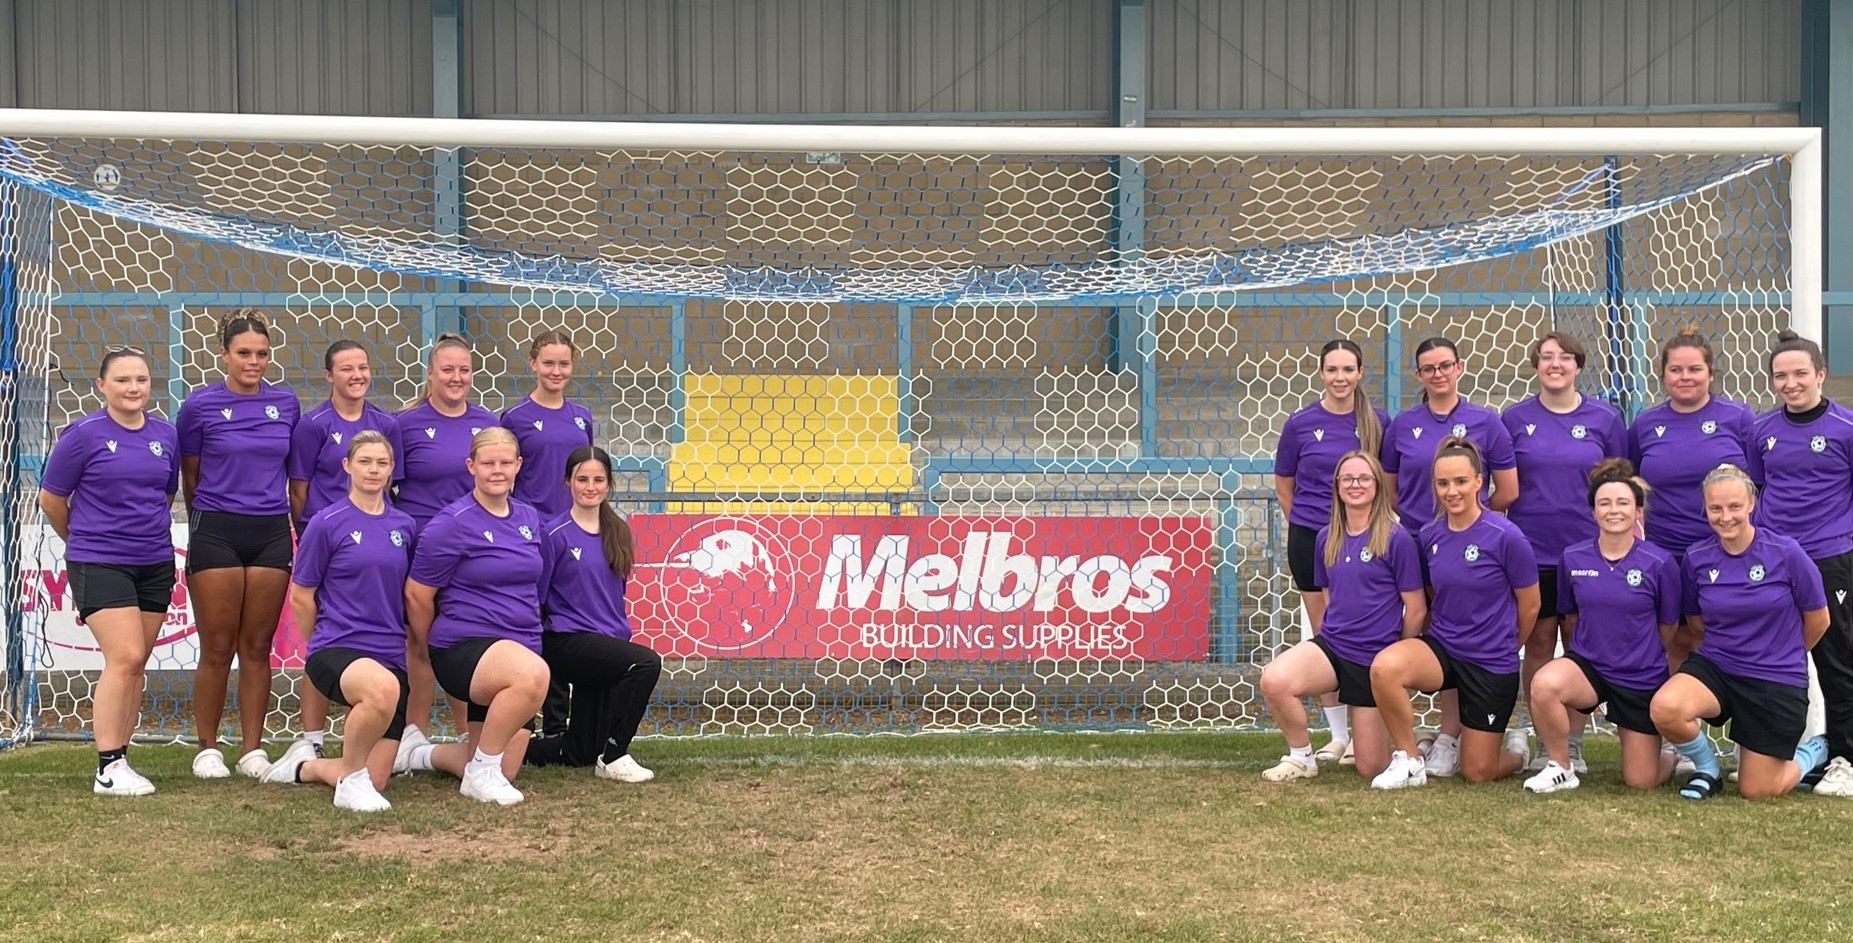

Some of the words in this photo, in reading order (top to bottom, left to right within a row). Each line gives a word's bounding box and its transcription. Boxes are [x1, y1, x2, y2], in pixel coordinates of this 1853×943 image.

[816, 532, 1173, 613] Melbros
[862, 624, 994, 648] BUILDING
[1002, 625, 1127, 649] SUPPLIES
